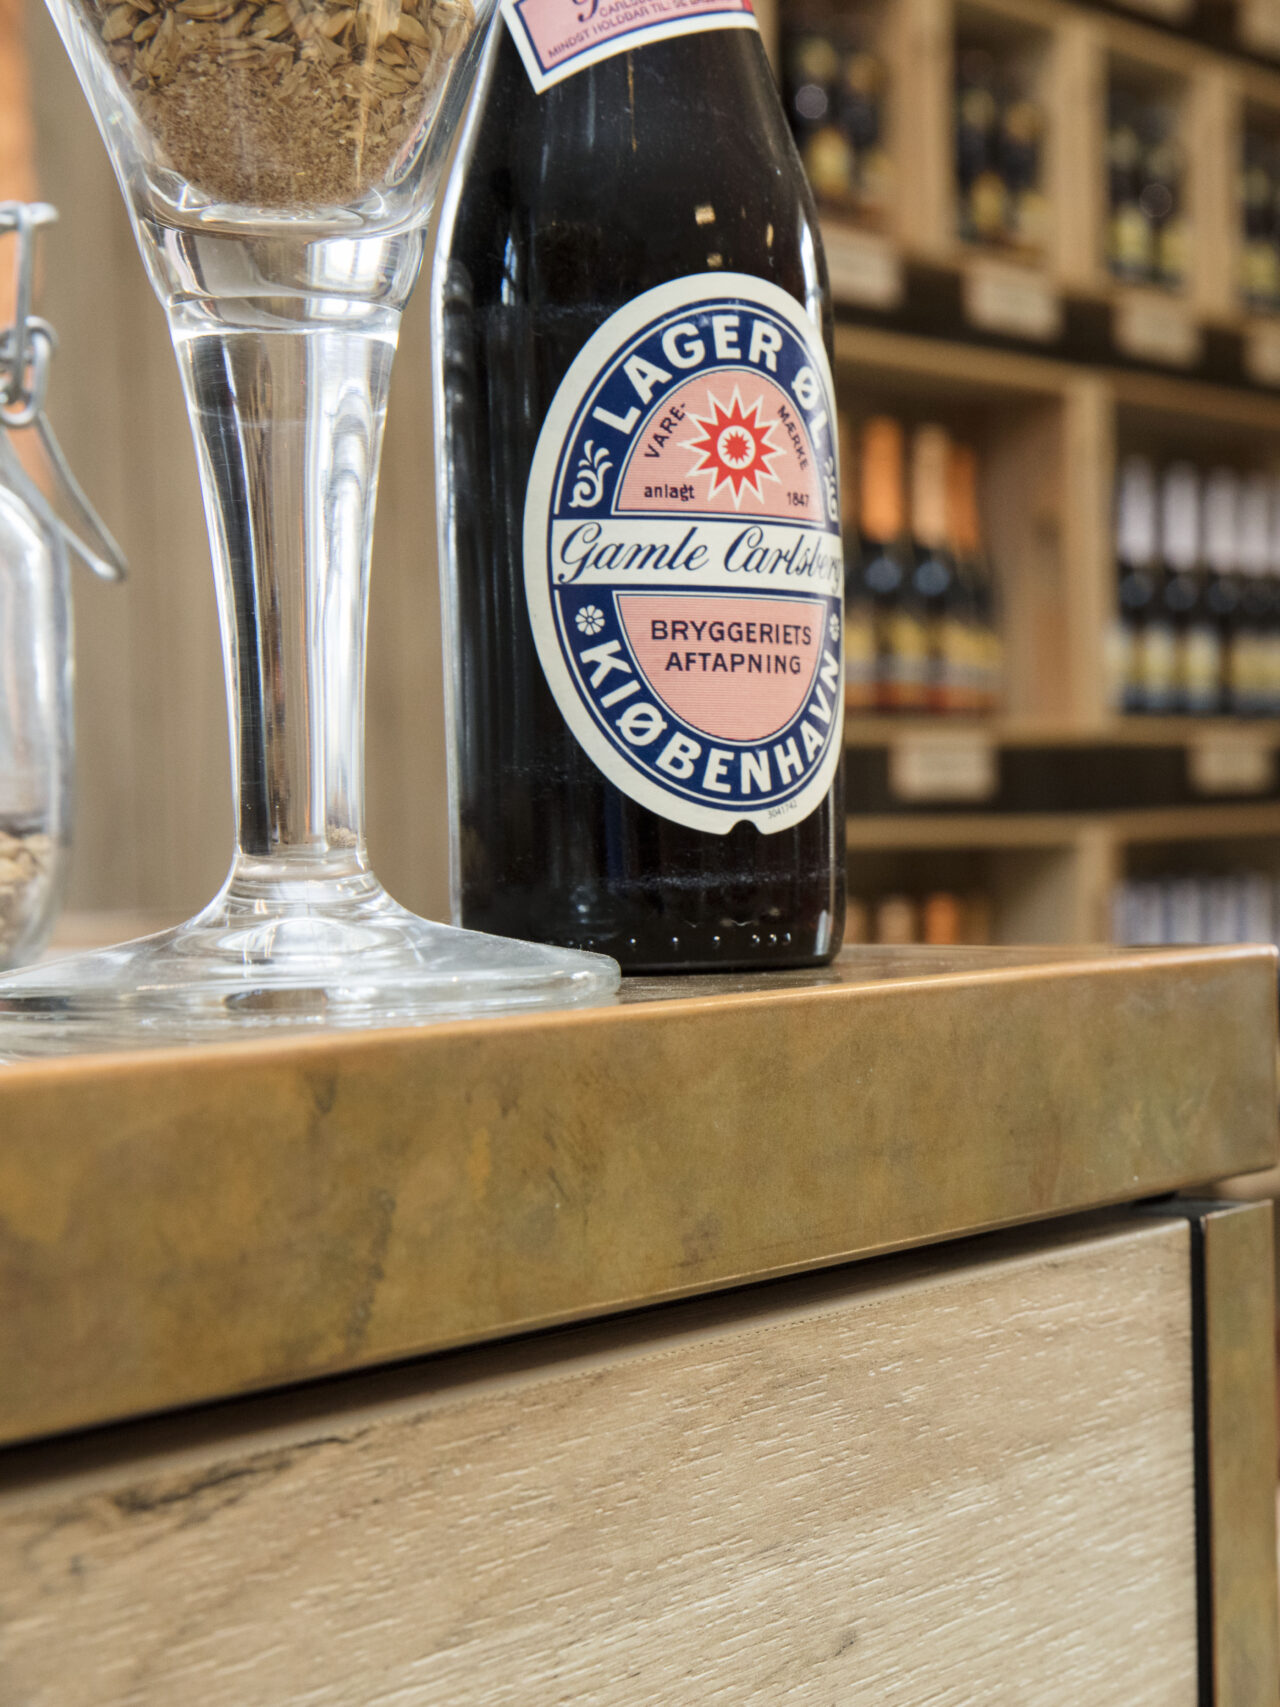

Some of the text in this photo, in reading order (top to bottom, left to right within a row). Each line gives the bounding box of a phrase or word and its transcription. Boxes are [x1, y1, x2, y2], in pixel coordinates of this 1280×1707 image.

[547, 28, 590, 58] MINDST
[592, 6, 650, 34] HOLDBAR
[592, 315, 828, 449] LAGER ØL
[644, 403, 808, 471] VARE- MÆRKE
[644, 484, 809, 507] anlagt 1847
[557, 522, 842, 594] Gamle Carlsberg
[651, 619, 812, 647] BRYGGERIETS
[665, 651, 802, 675] AFTAPNING
[579, 640, 840, 795] KIØBENHAVN
